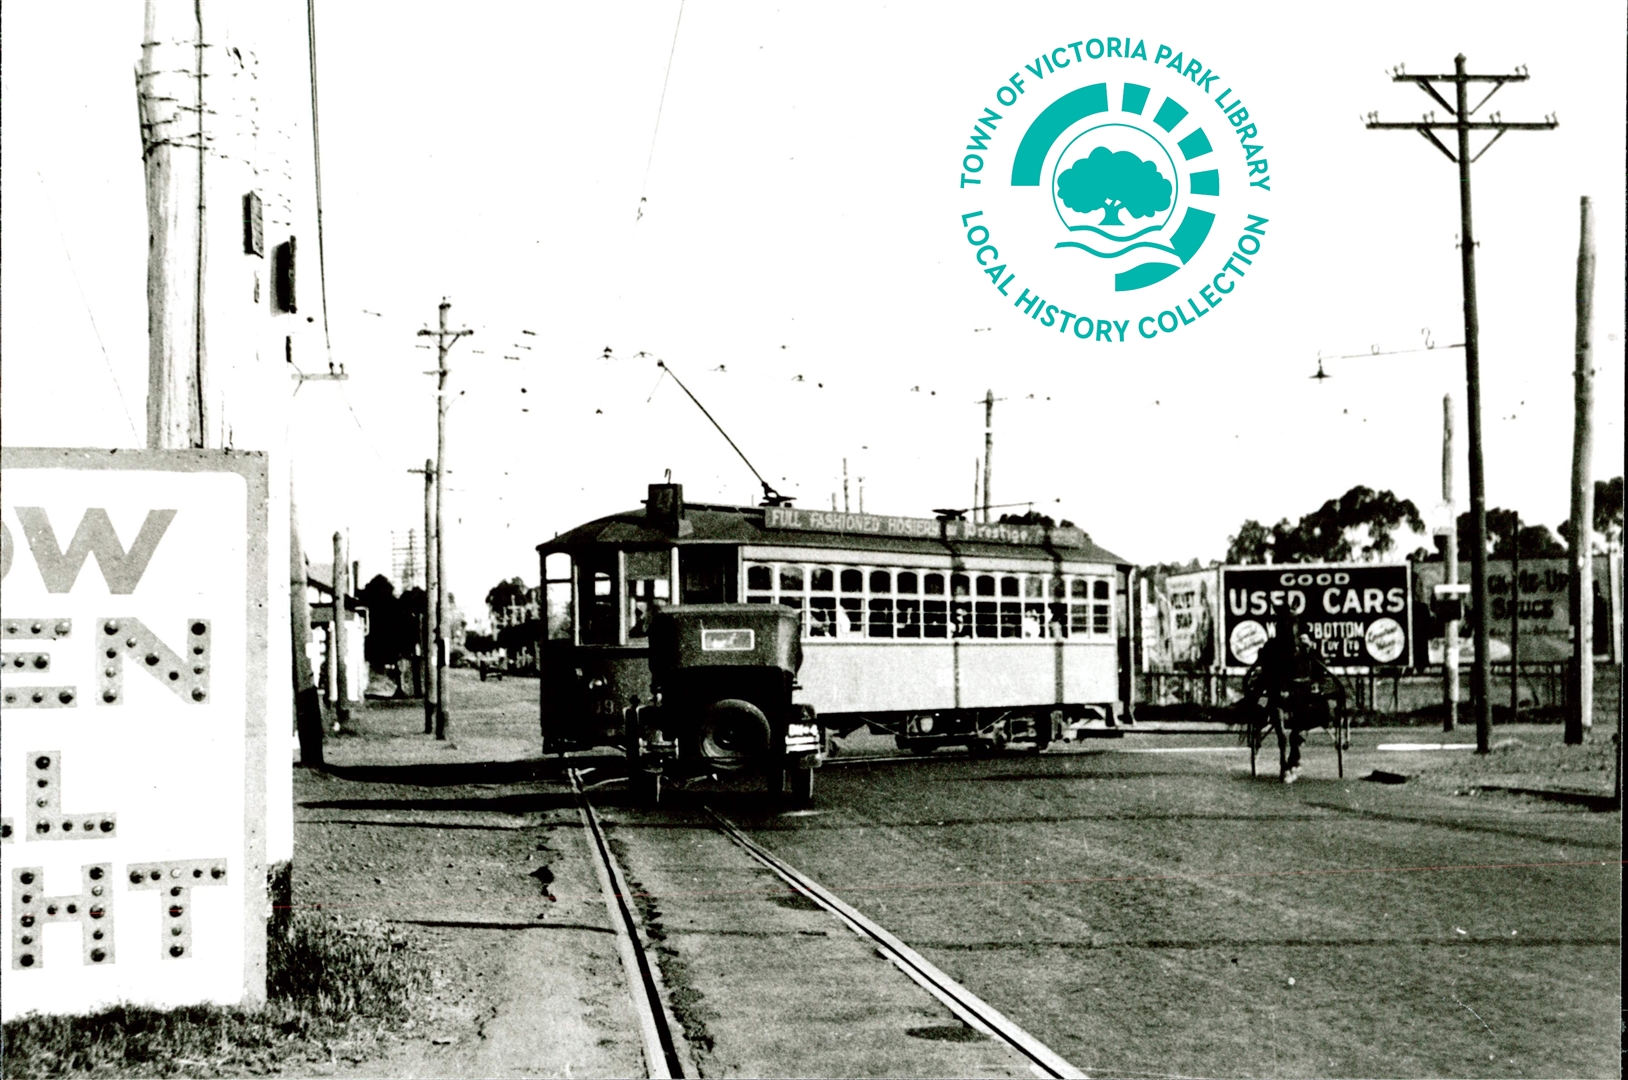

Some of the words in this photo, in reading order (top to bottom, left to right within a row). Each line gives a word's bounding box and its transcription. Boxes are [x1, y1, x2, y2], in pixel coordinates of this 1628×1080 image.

[772, 509, 801, 527] FULL
[809, 512, 880, 533] FASHIONED
[0, 506, 178, 594] W
[1280, 573, 1350, 586] GOOD
[1229, 588, 1306, 616] USED
[1323, 588, 1405, 615] CARS
